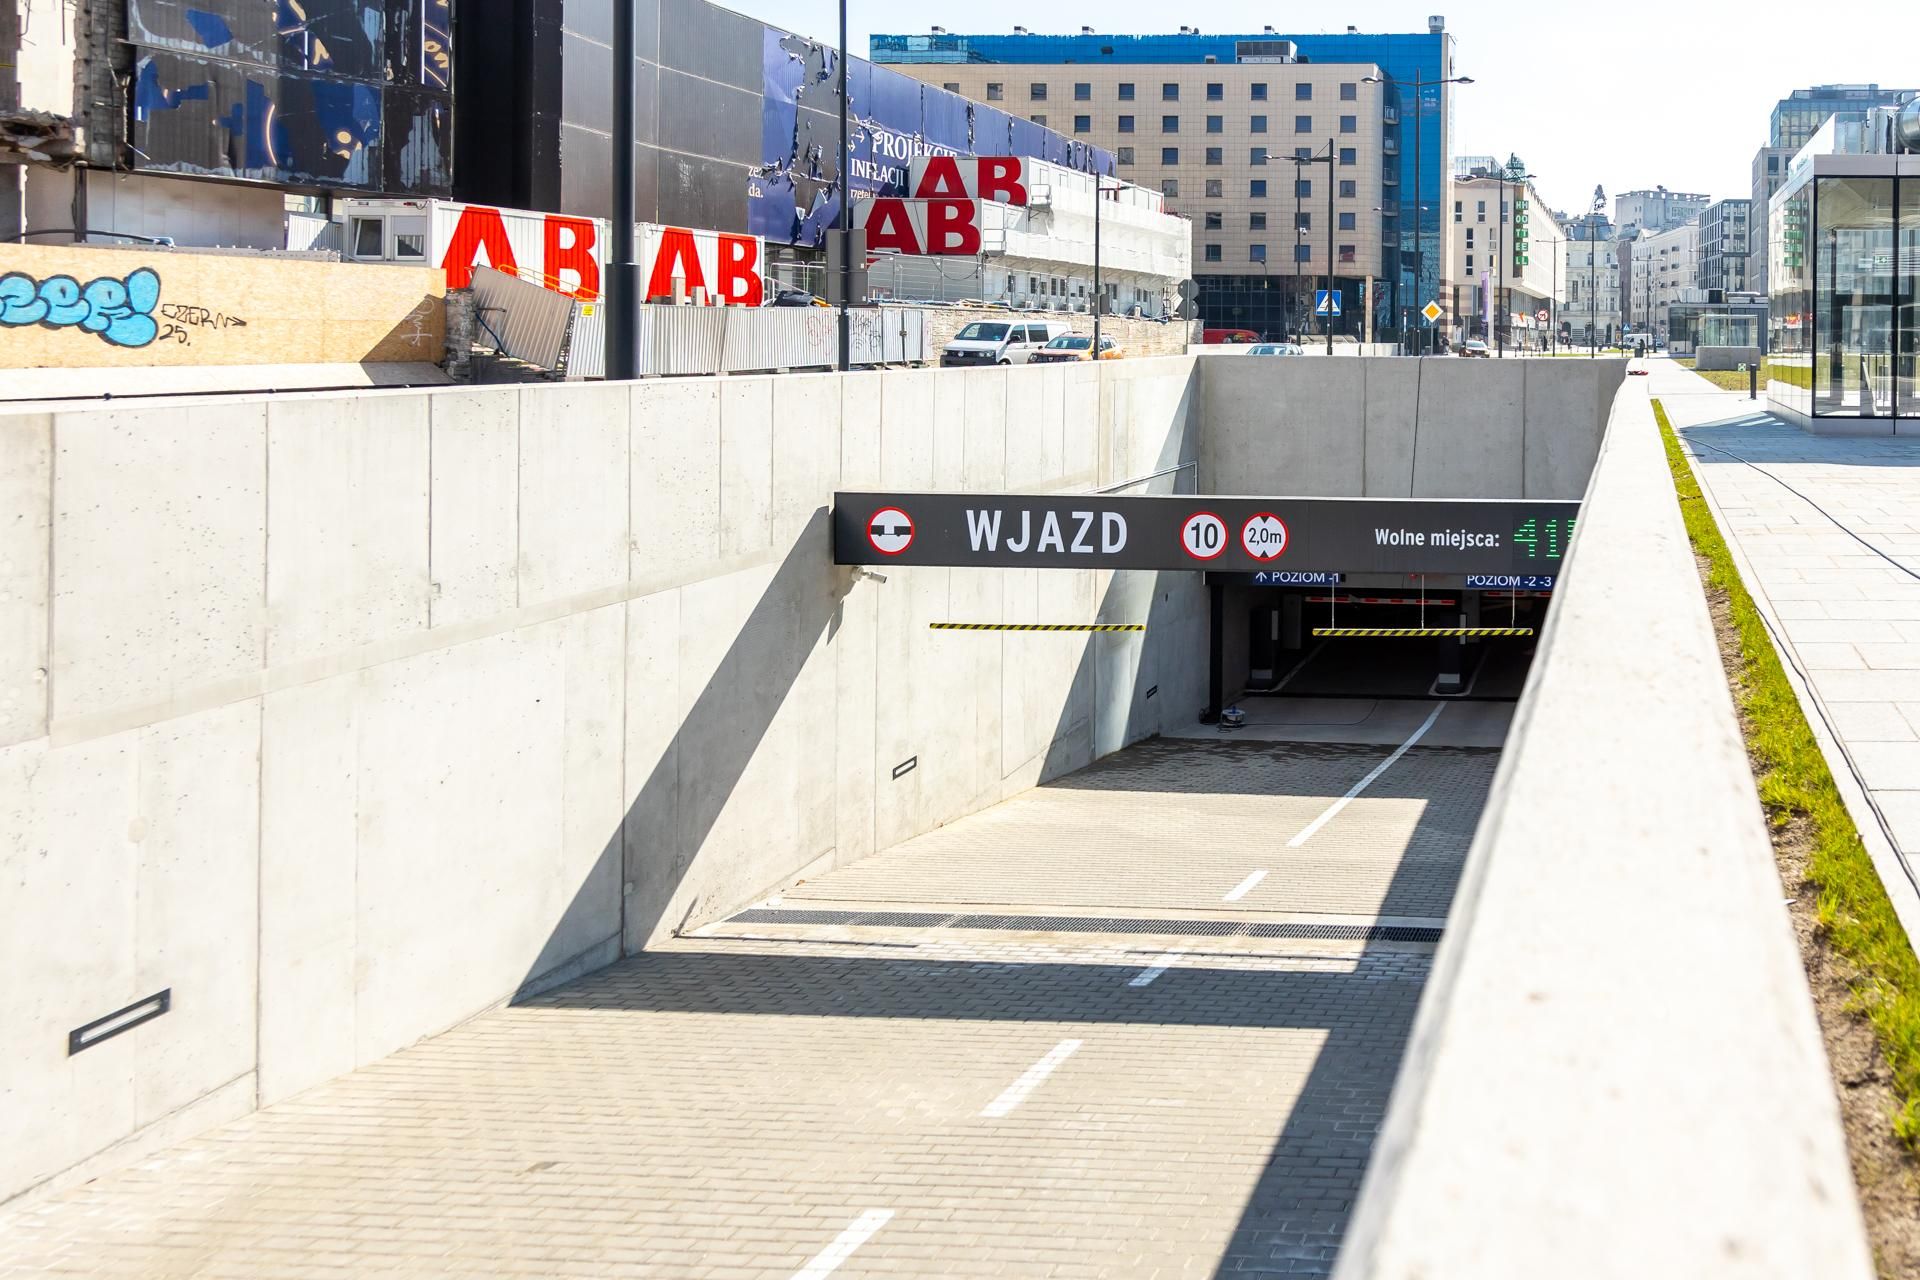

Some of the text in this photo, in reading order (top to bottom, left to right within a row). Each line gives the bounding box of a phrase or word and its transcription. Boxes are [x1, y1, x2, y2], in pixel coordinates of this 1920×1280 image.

[914, 157, 1028, 207] AB
[864, 199, 981, 255] AB
[441, 206, 599, 301] AB
[646, 226, 764, 307] AB
[159, 324, 191, 346] 25.
[966, 510, 1128, 554] WJAZD
[1191, 522, 1219, 549] 10
[1248, 528, 1282, 546] 2,0m
[1375, 528, 1500, 550] Wolne miejsca:
[1272, 571, 1339, 583] POZIOM -1
[1467, 575, 1552, 587] POZIOM -2 -3
